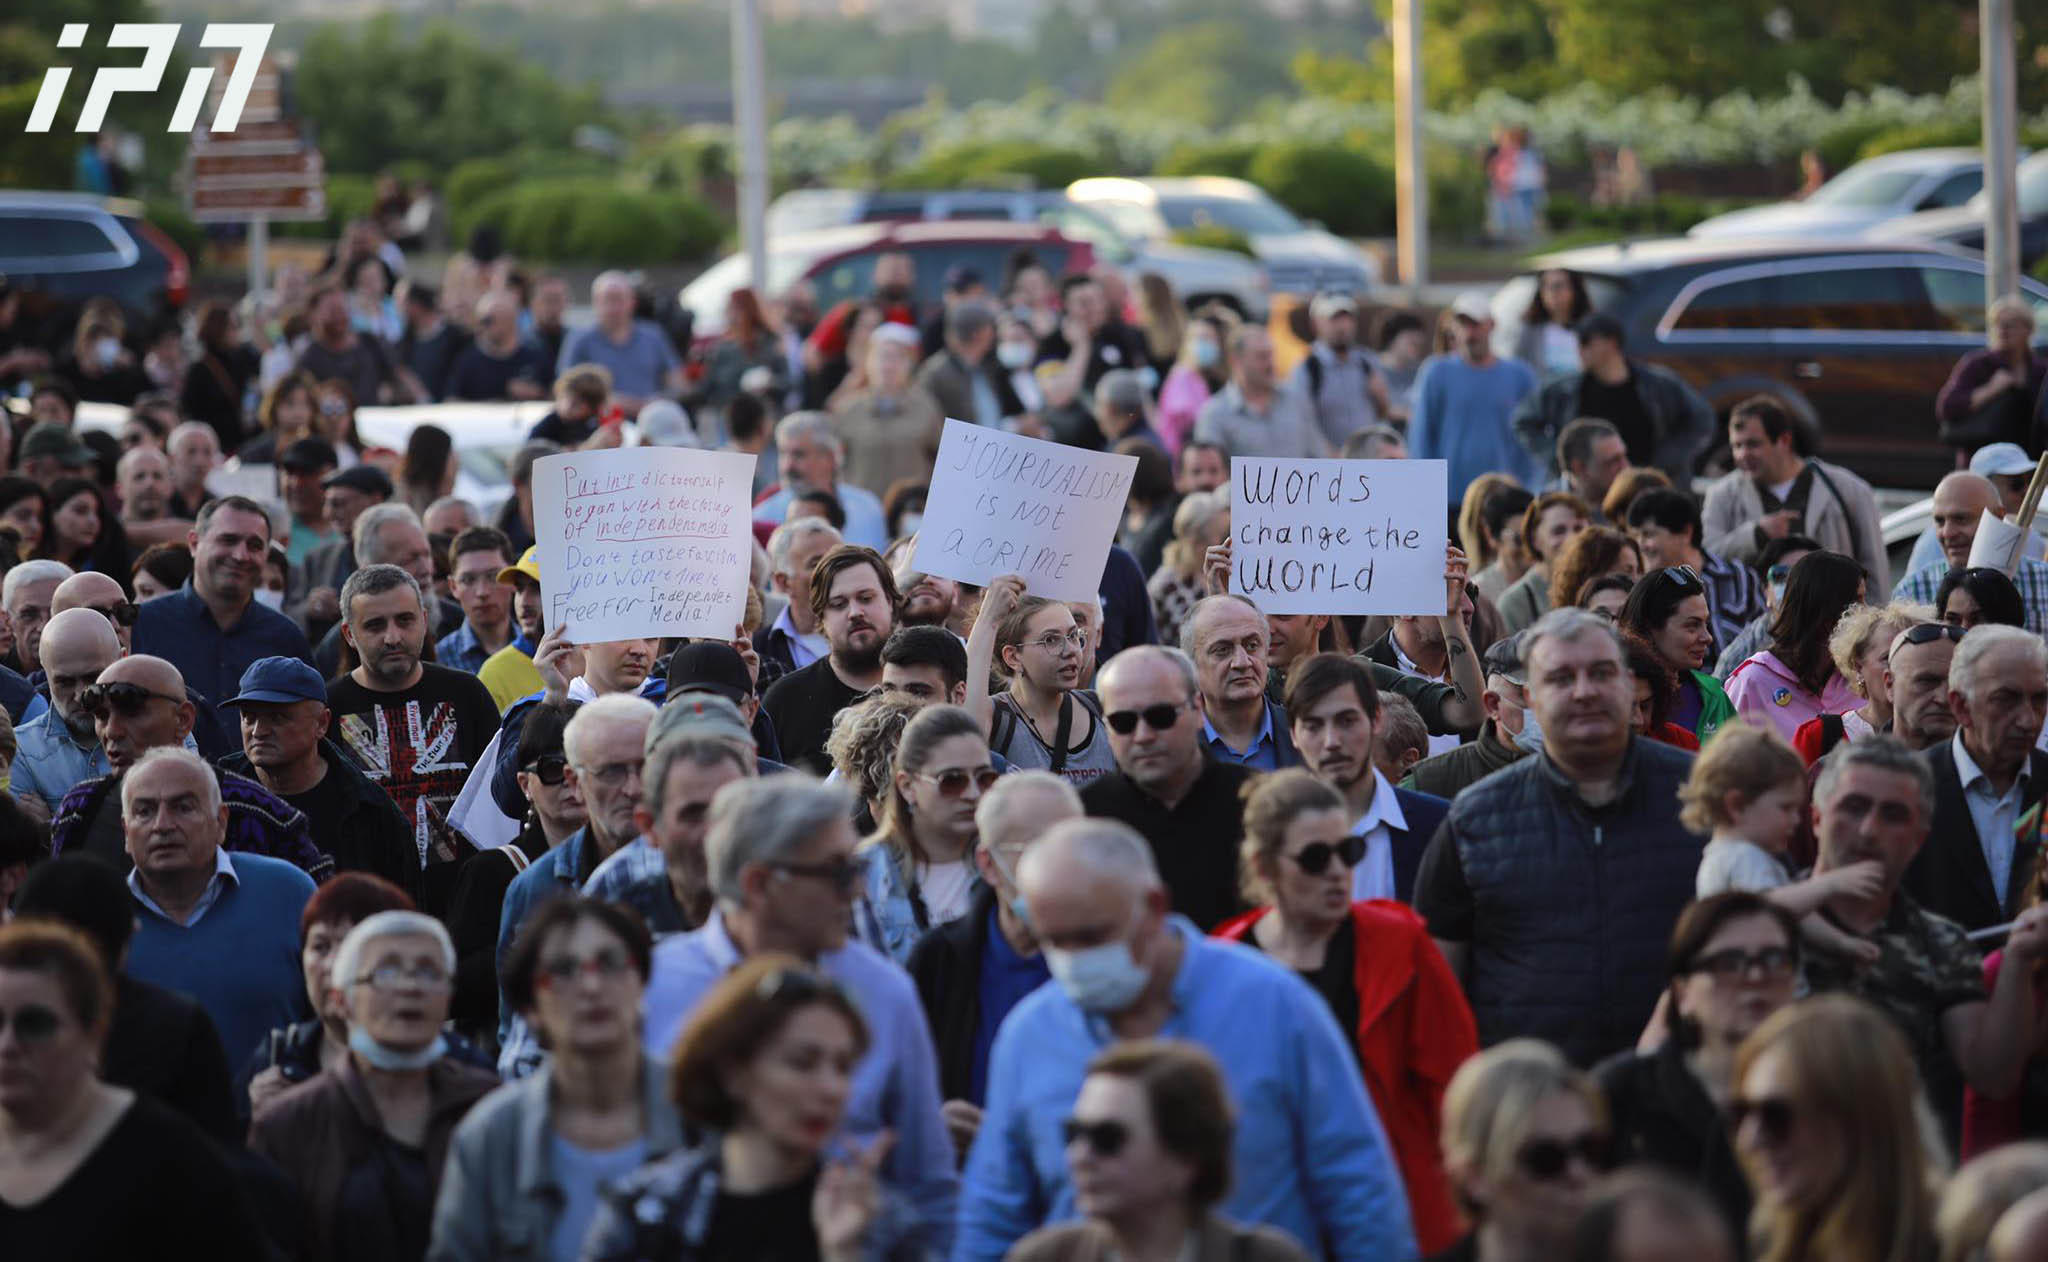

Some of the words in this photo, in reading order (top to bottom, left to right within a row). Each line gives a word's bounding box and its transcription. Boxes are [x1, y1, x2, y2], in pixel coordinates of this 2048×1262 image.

[954, 434, 1128, 500] JOURNALISM
[1243, 464, 1370, 512] Words
[565, 500, 615, 523] began
[622, 500, 660, 513] with
[669, 498, 690, 511] the
[1241, 517, 1351, 550] change
[1365, 516, 1419, 549] the
[973, 538, 1072, 579] CRIME
[567, 573, 607, 599] you
